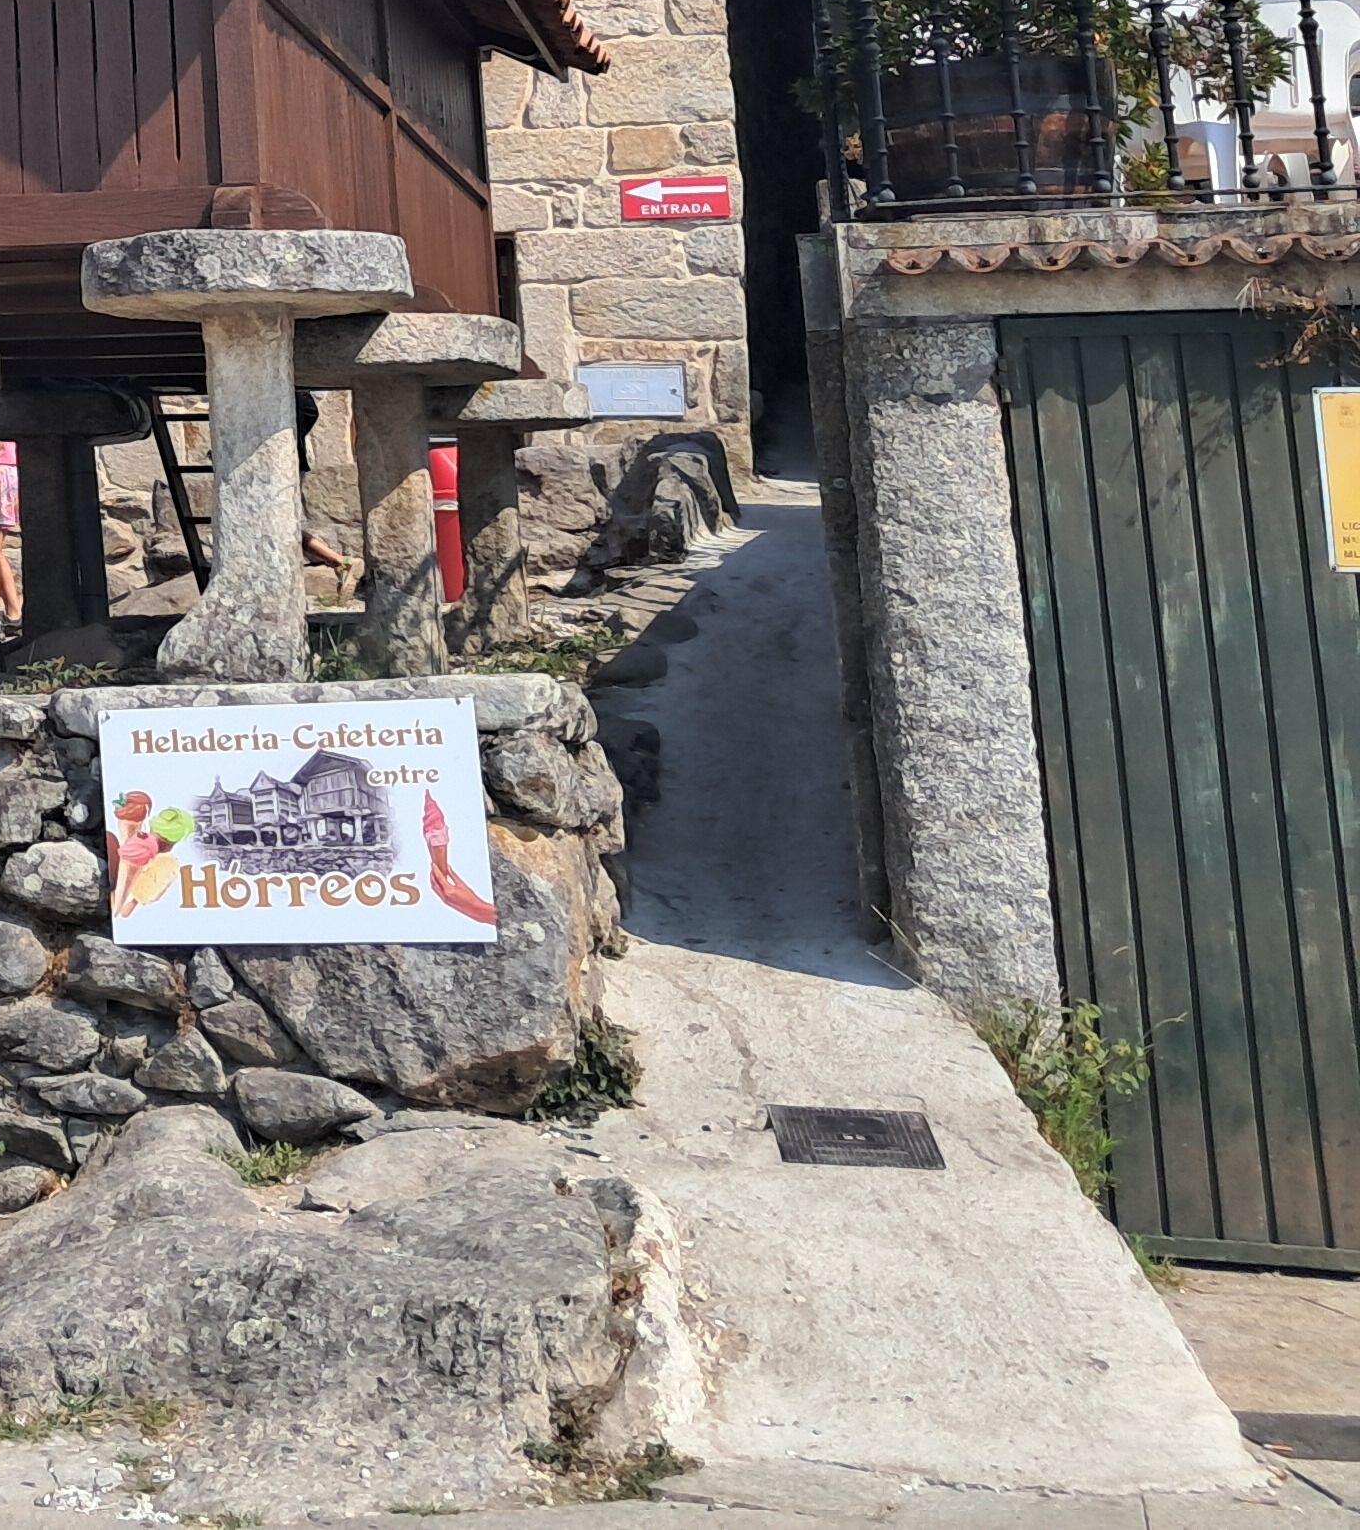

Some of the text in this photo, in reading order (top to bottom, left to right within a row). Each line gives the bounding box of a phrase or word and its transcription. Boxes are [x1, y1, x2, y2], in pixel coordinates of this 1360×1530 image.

[641, 203, 712, 214] ENTRADA
[368, 765, 440, 787] entre
[180, 861, 421, 908] Hórreos
